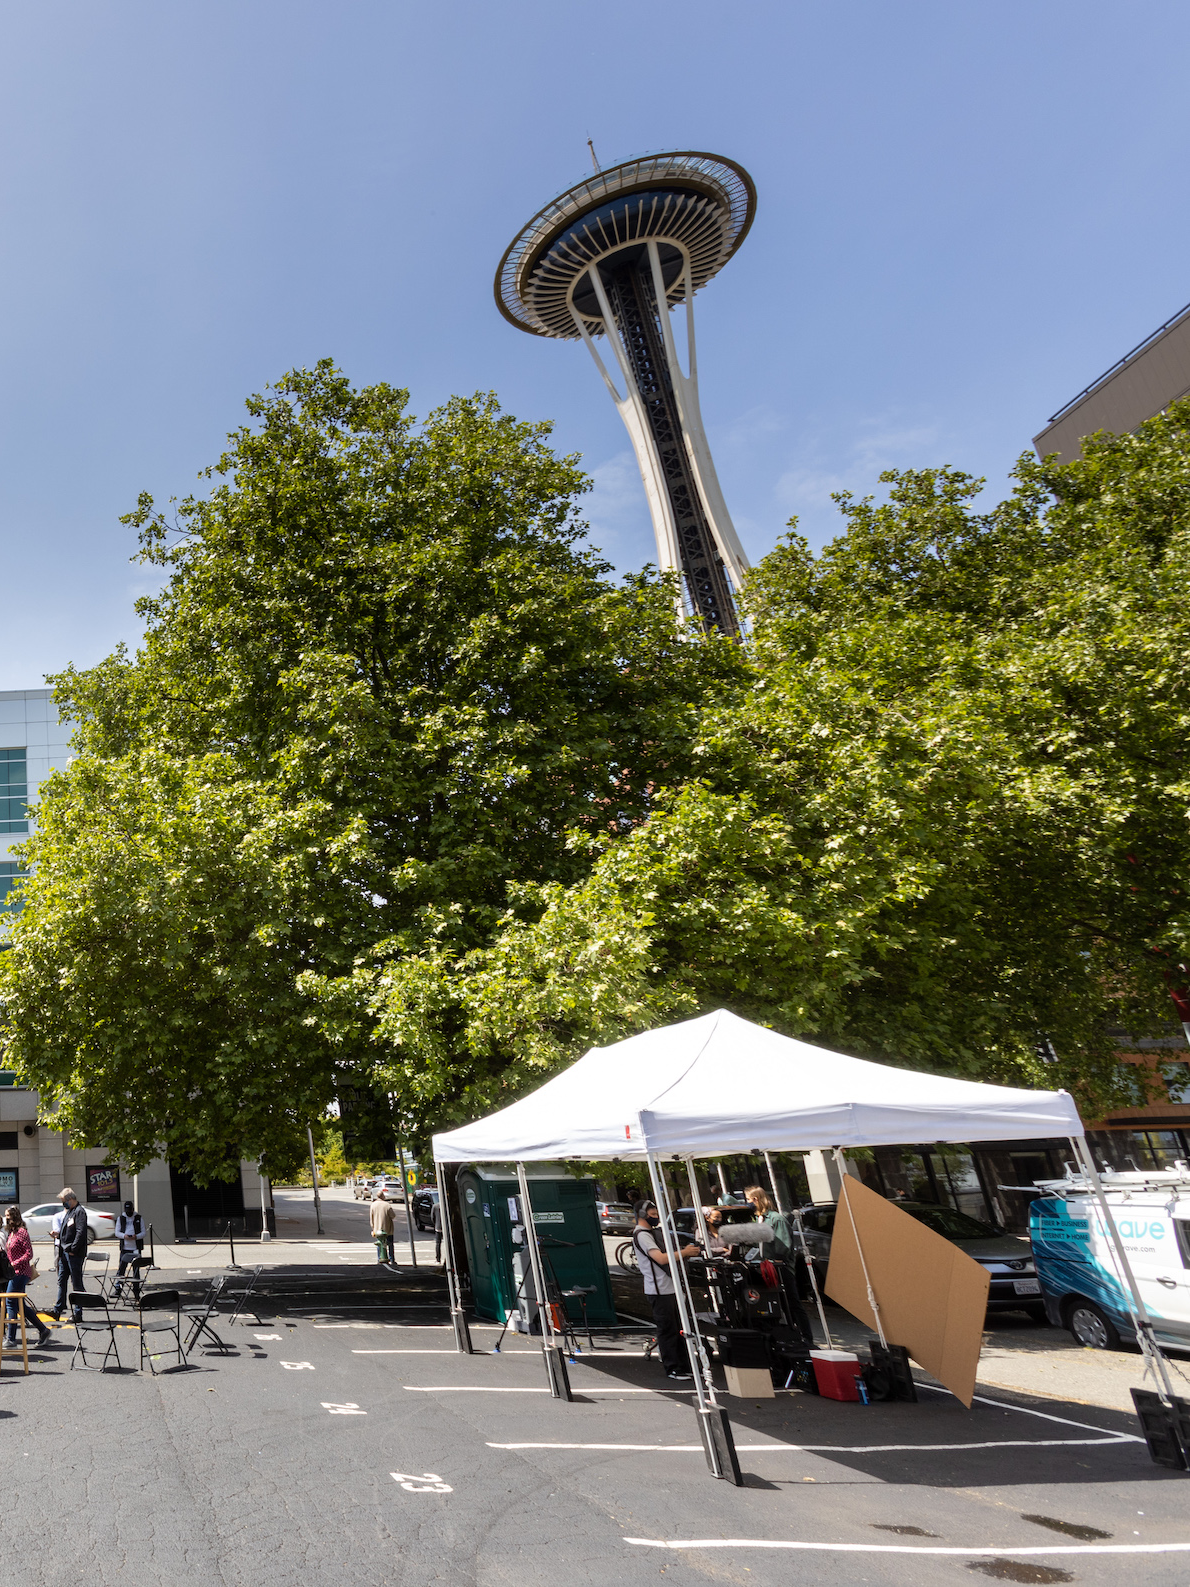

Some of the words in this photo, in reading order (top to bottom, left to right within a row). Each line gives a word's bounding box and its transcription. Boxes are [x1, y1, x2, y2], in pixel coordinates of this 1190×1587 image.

[90, 1171, 113, 1185] STAR
[97, 1178, 113, 1186] 101.5
[1061, 1220, 1088, 1228] BUSINESS
[1096, 1219, 1165, 1240] wave
[279, 1361, 315, 1370] 25
[320, 1402, 368, 1414] 24
[389, 1472, 454, 1493] 23
